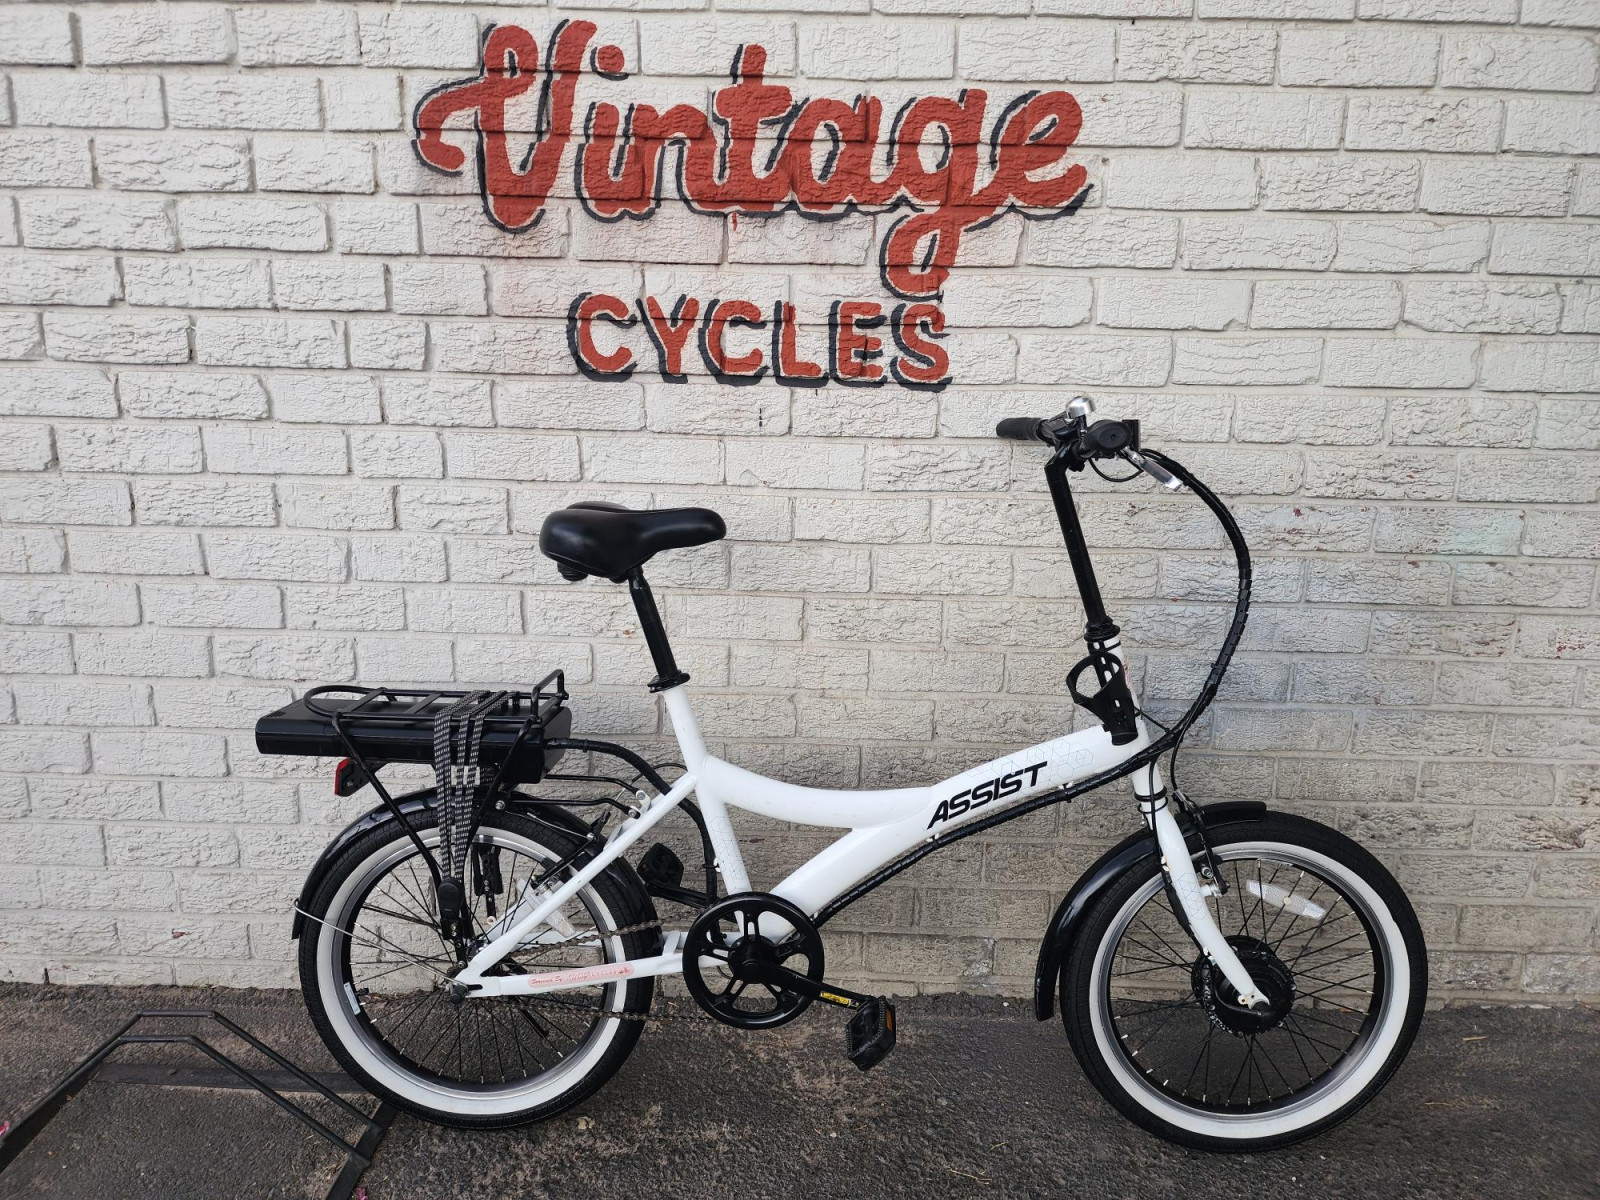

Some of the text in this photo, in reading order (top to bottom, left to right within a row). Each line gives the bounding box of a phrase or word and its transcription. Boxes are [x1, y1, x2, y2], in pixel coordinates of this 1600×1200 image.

[414, 20, 1092, 298] Vintage
[567, 292, 952, 391] CYCLES
[927, 761, 1048, 829] ASSIST
